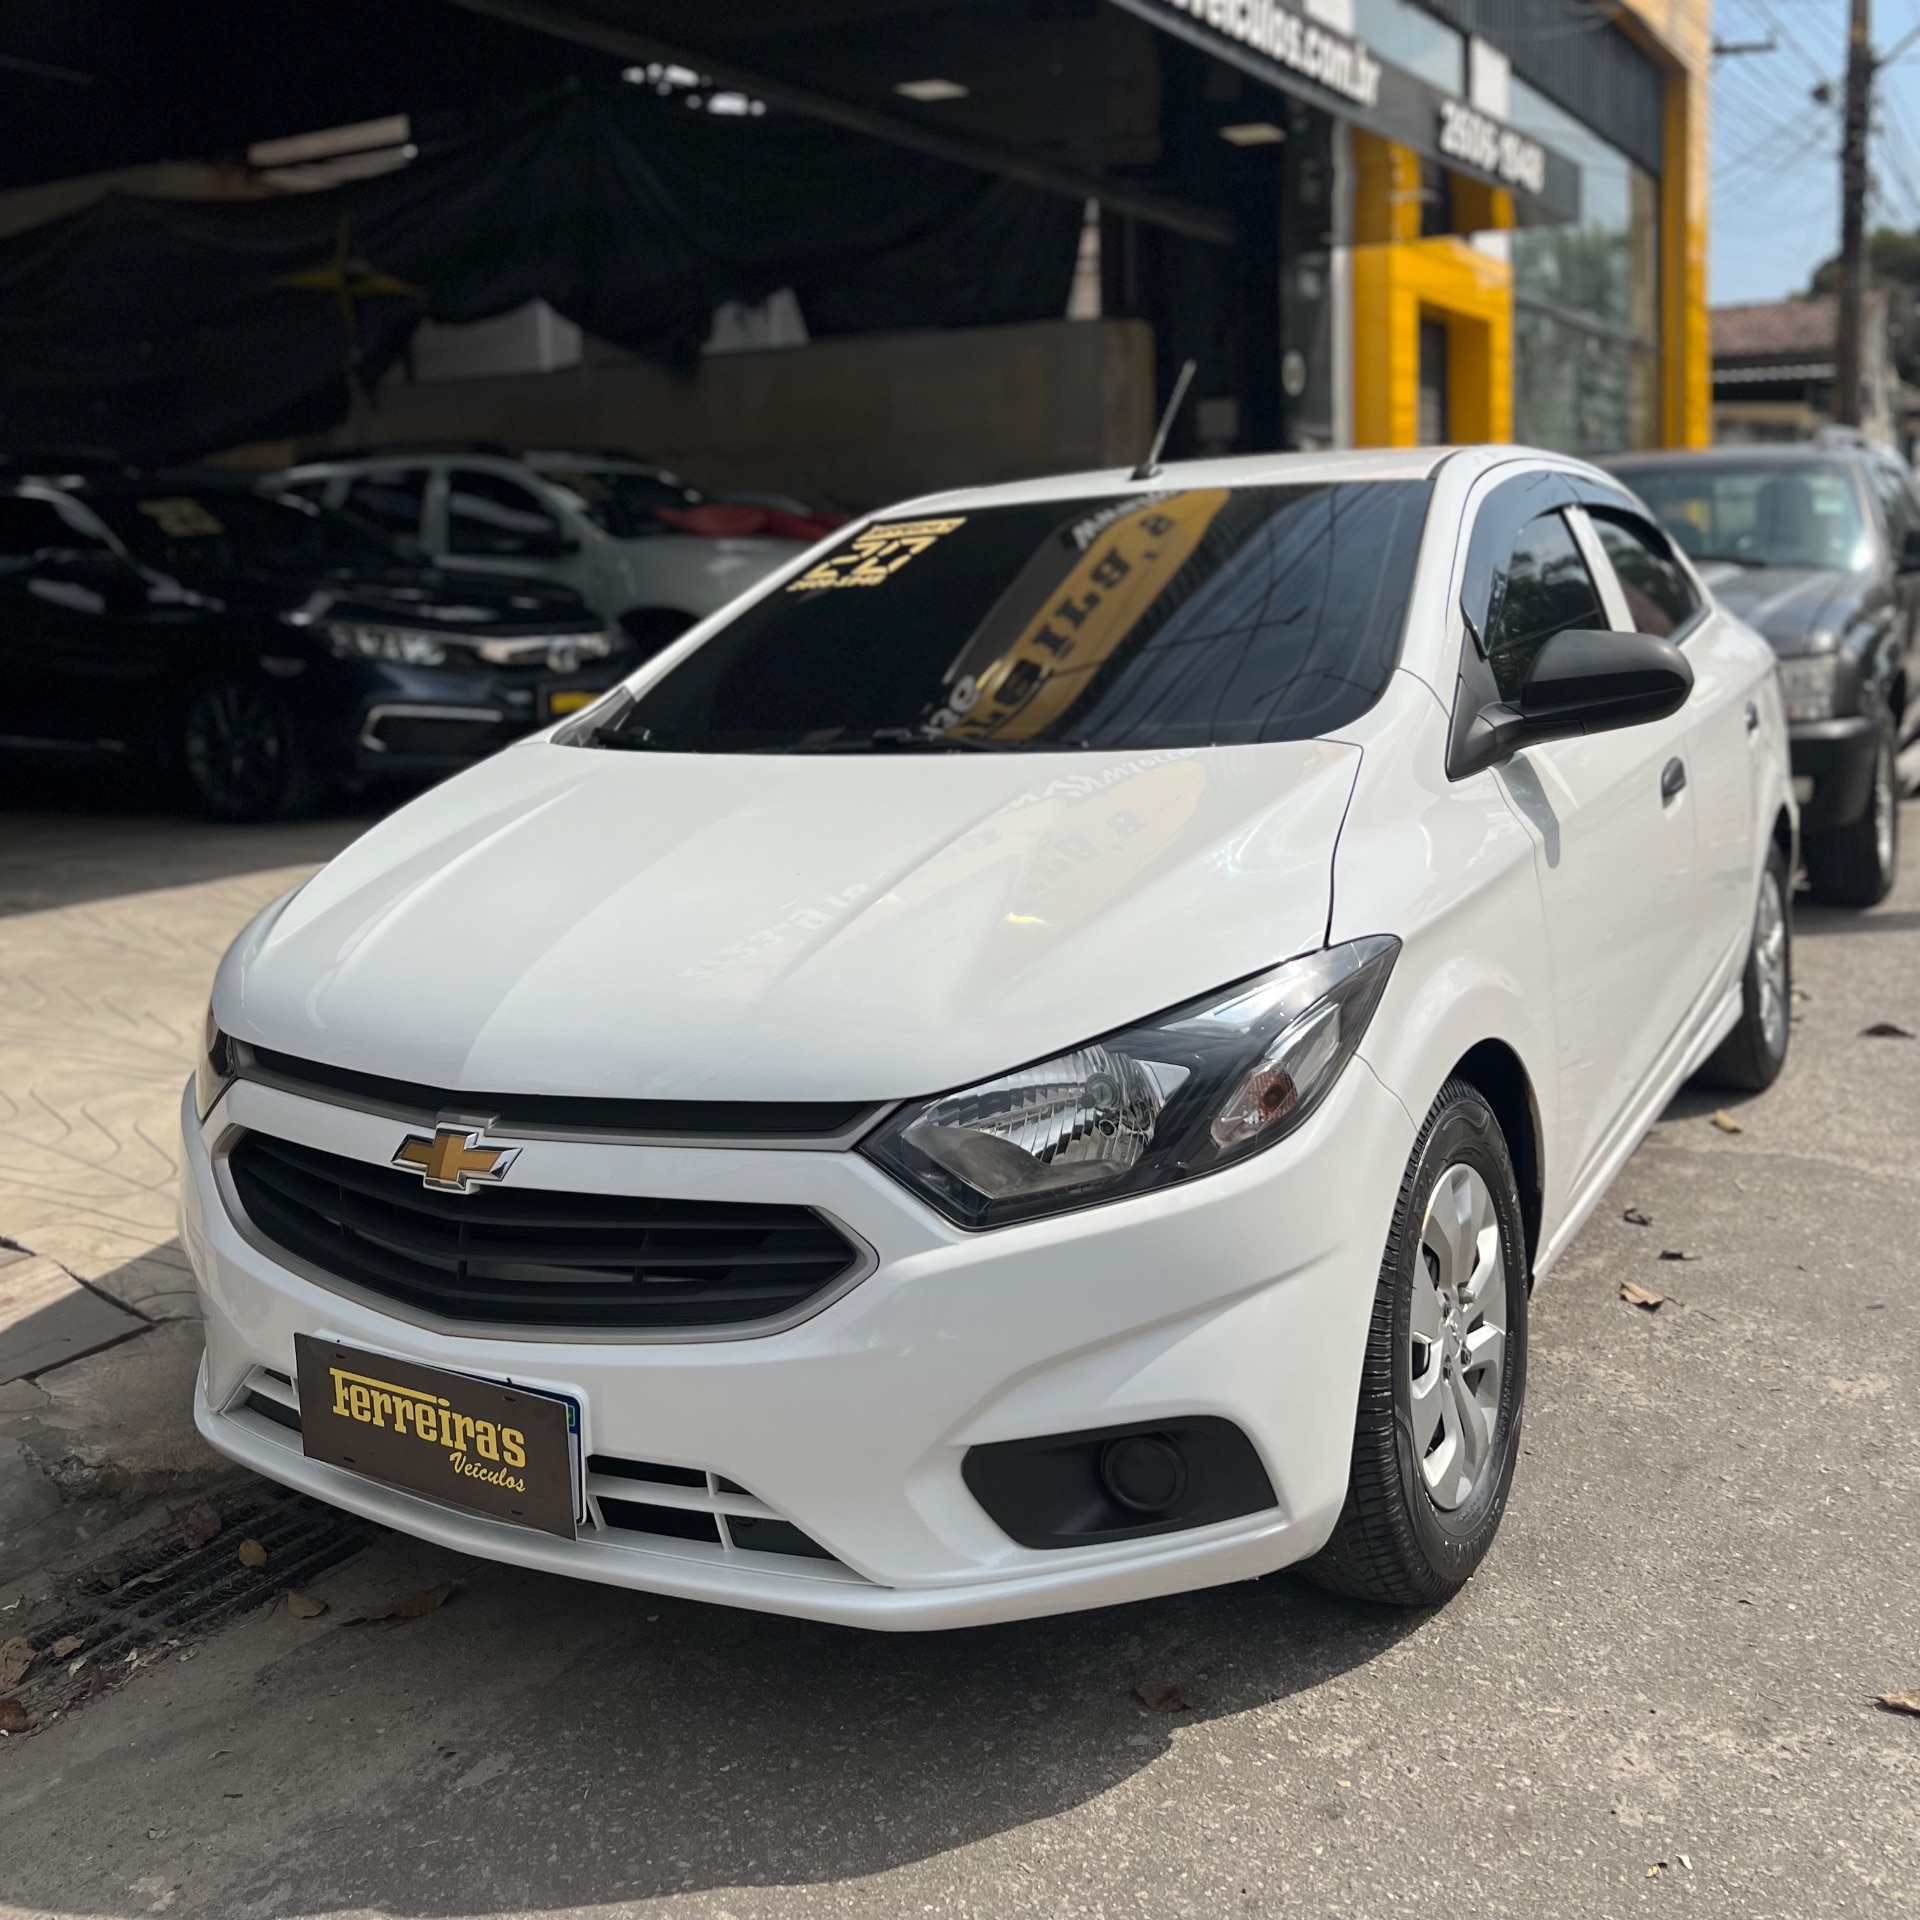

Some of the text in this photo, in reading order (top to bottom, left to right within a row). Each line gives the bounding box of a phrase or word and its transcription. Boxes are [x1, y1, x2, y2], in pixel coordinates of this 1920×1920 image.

[1170, 0, 1381, 107] veiculos.com.br
[329, 1367, 526, 1468] Ferreira's
[450, 1451, 526, 1492] Veículos
